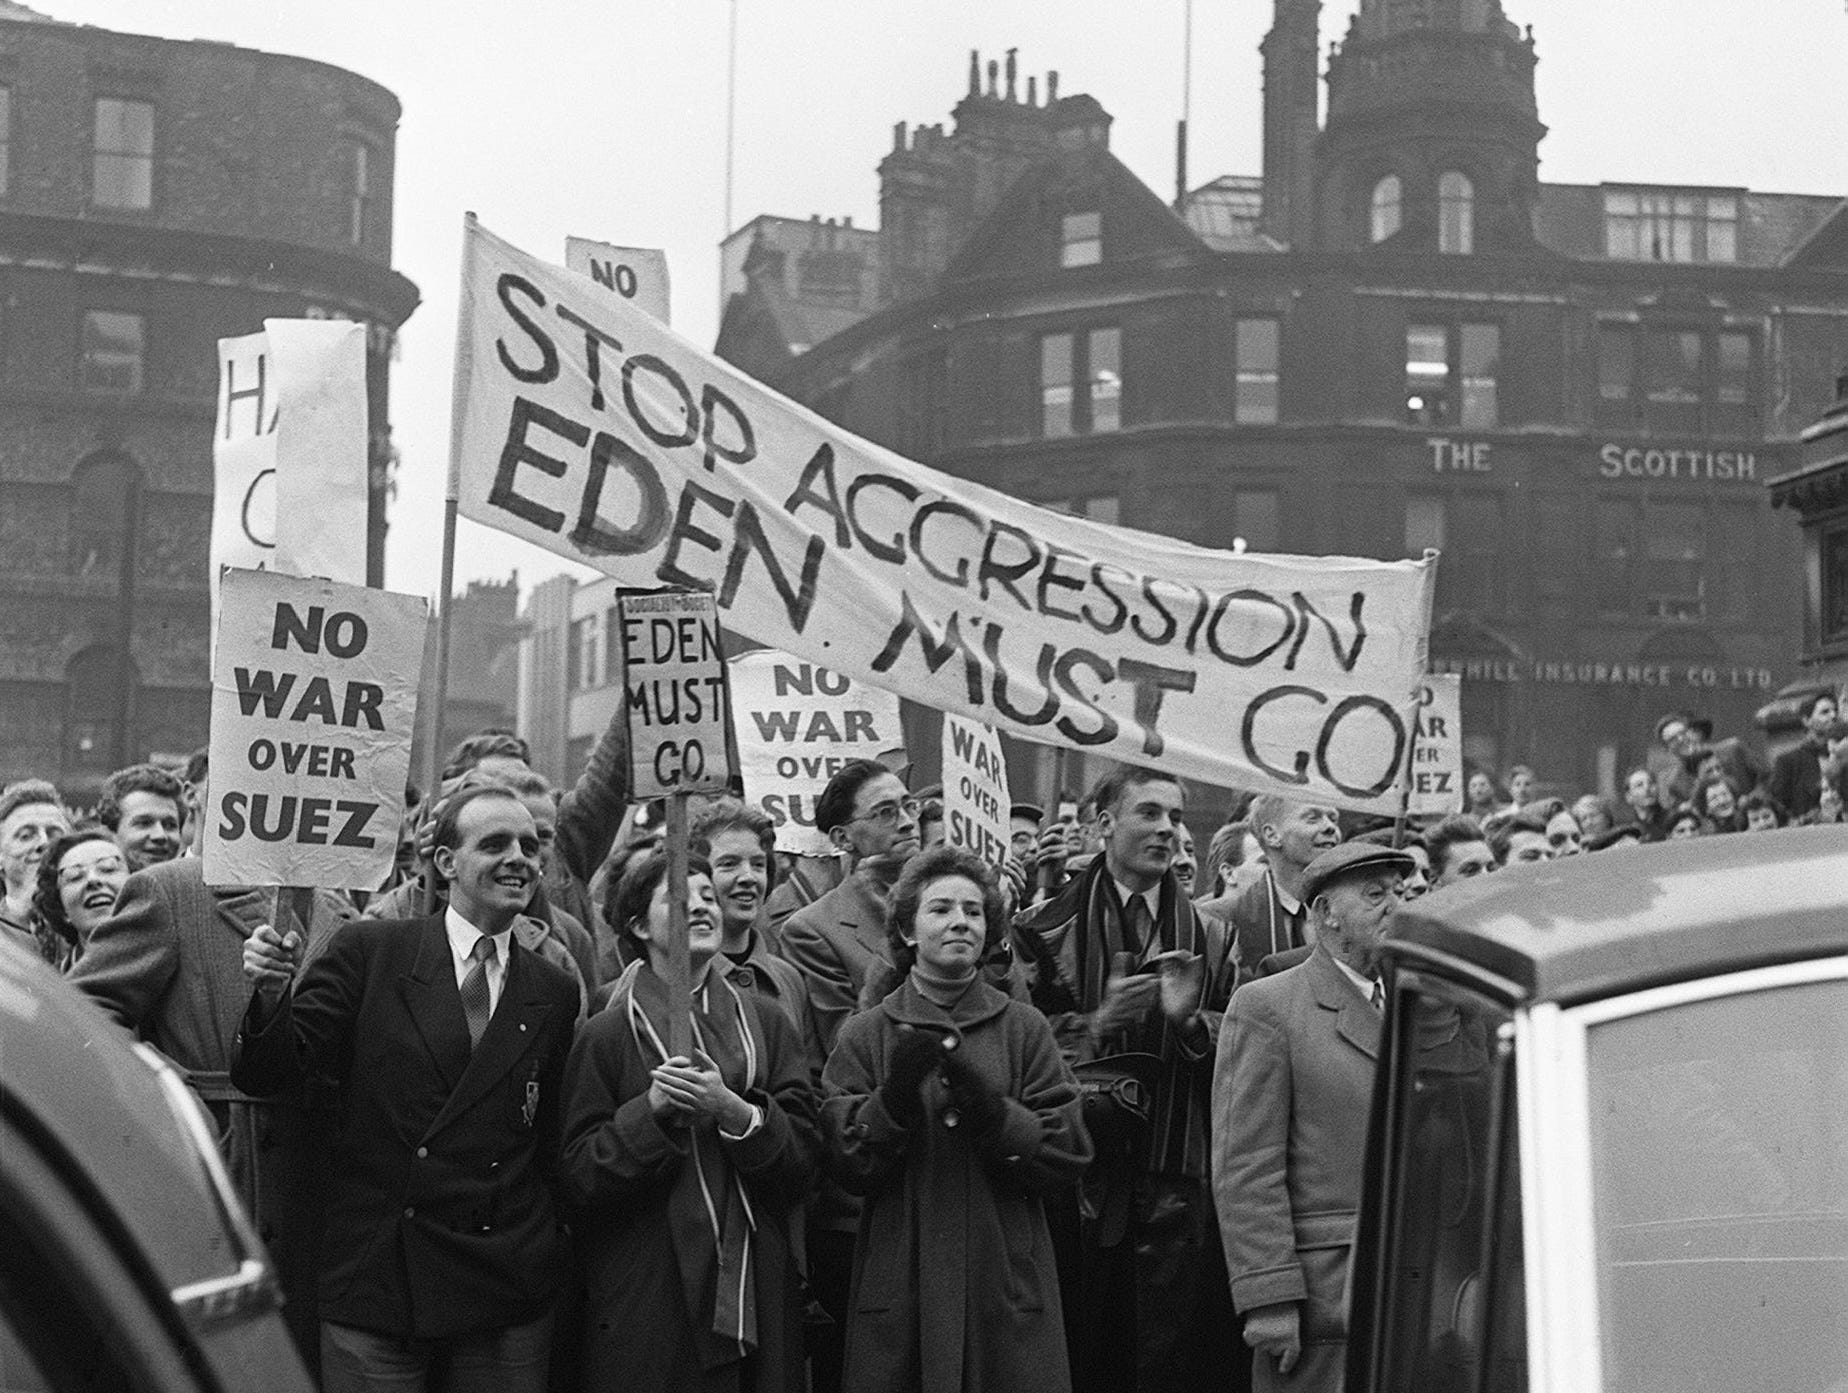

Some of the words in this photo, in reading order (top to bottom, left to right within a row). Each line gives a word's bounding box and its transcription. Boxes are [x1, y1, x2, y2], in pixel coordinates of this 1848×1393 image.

[590, 258, 637, 298] NO
[496, 272, 757, 473] STOP
[784, 442, 1366, 671] AGGRESSION
[1427, 437, 1492, 472] THE
[1600, 443, 1755, 480] SCOTTISH
[488, 396, 825, 634] EDEN
[871, 589, 1196, 757] MUST
[1242, 685, 1406, 798] GO
[271, 602, 368, 659] NO
[624, 617, 721, 665] EDEN
[234, 667, 386, 731] WAR
[773, 664, 850, 696] NO
[1535, 662, 1671, 687] INSURANCE
[1687, 665, 1716, 687] CO
[1731, 667, 1771, 689] LTD
[626, 677, 724, 726] MUST
[751, 710, 880, 742] WAR
[248, 738, 356, 780] OVER
[654, 738, 711, 788] GO.
[776, 756, 860, 779] OVE
[951, 721, 1003, 792] WAR
[219, 791, 380, 849] SUEZ
[761, 794, 818, 827] SU
[960, 776, 999, 823] OVER
